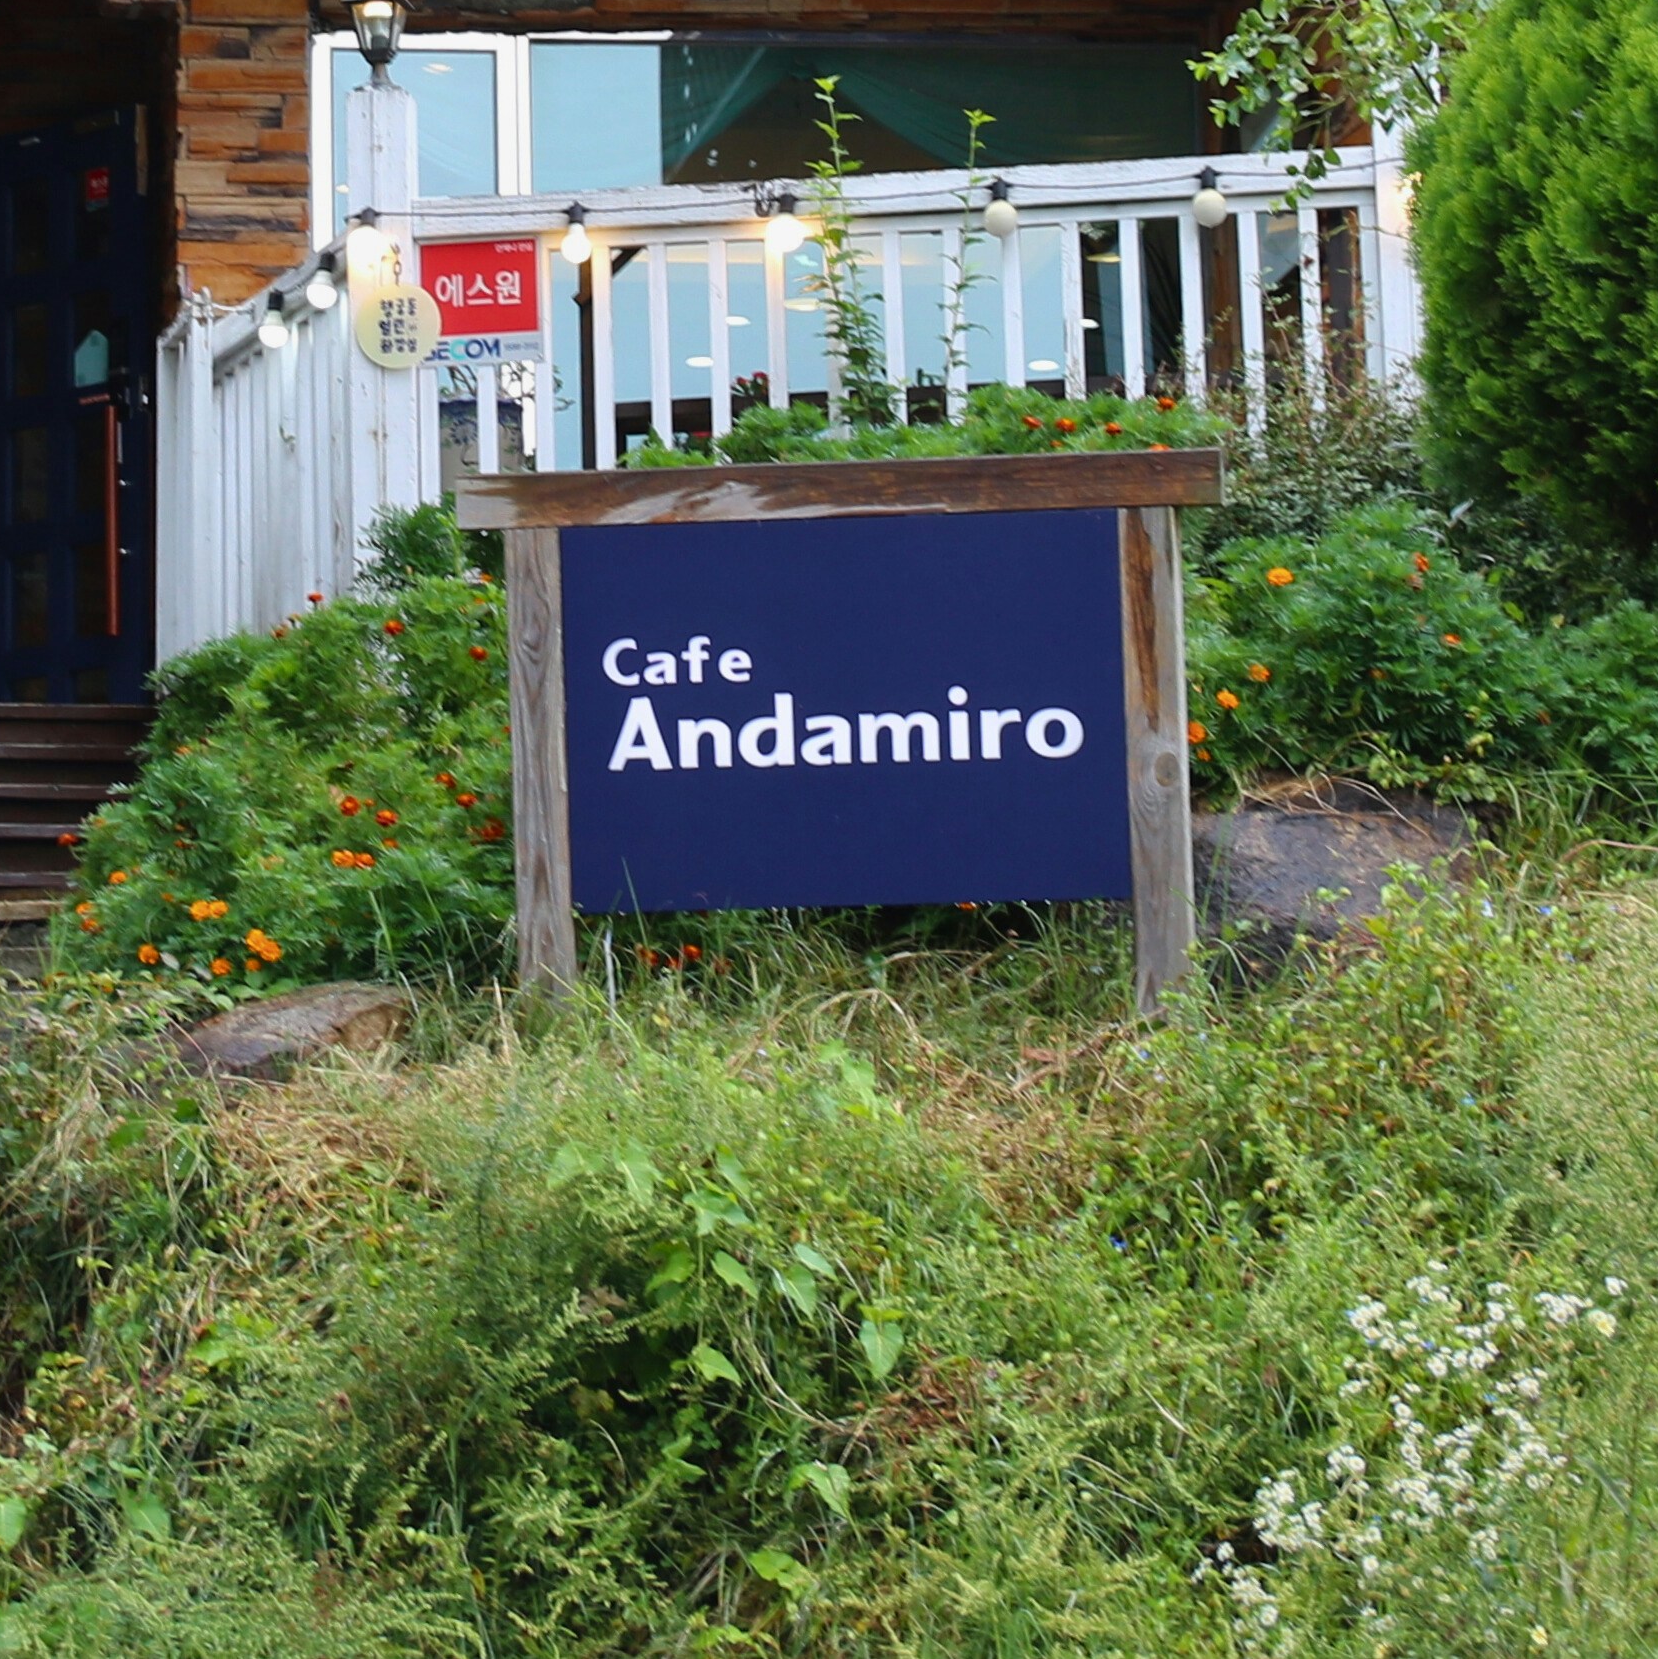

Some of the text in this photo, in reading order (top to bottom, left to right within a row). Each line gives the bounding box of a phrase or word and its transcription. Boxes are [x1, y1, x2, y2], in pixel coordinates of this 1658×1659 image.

[435, 271, 522, 308] 에스원
[601, 635, 753, 686] Cafe
[608, 686, 1085, 771] Andamiro
